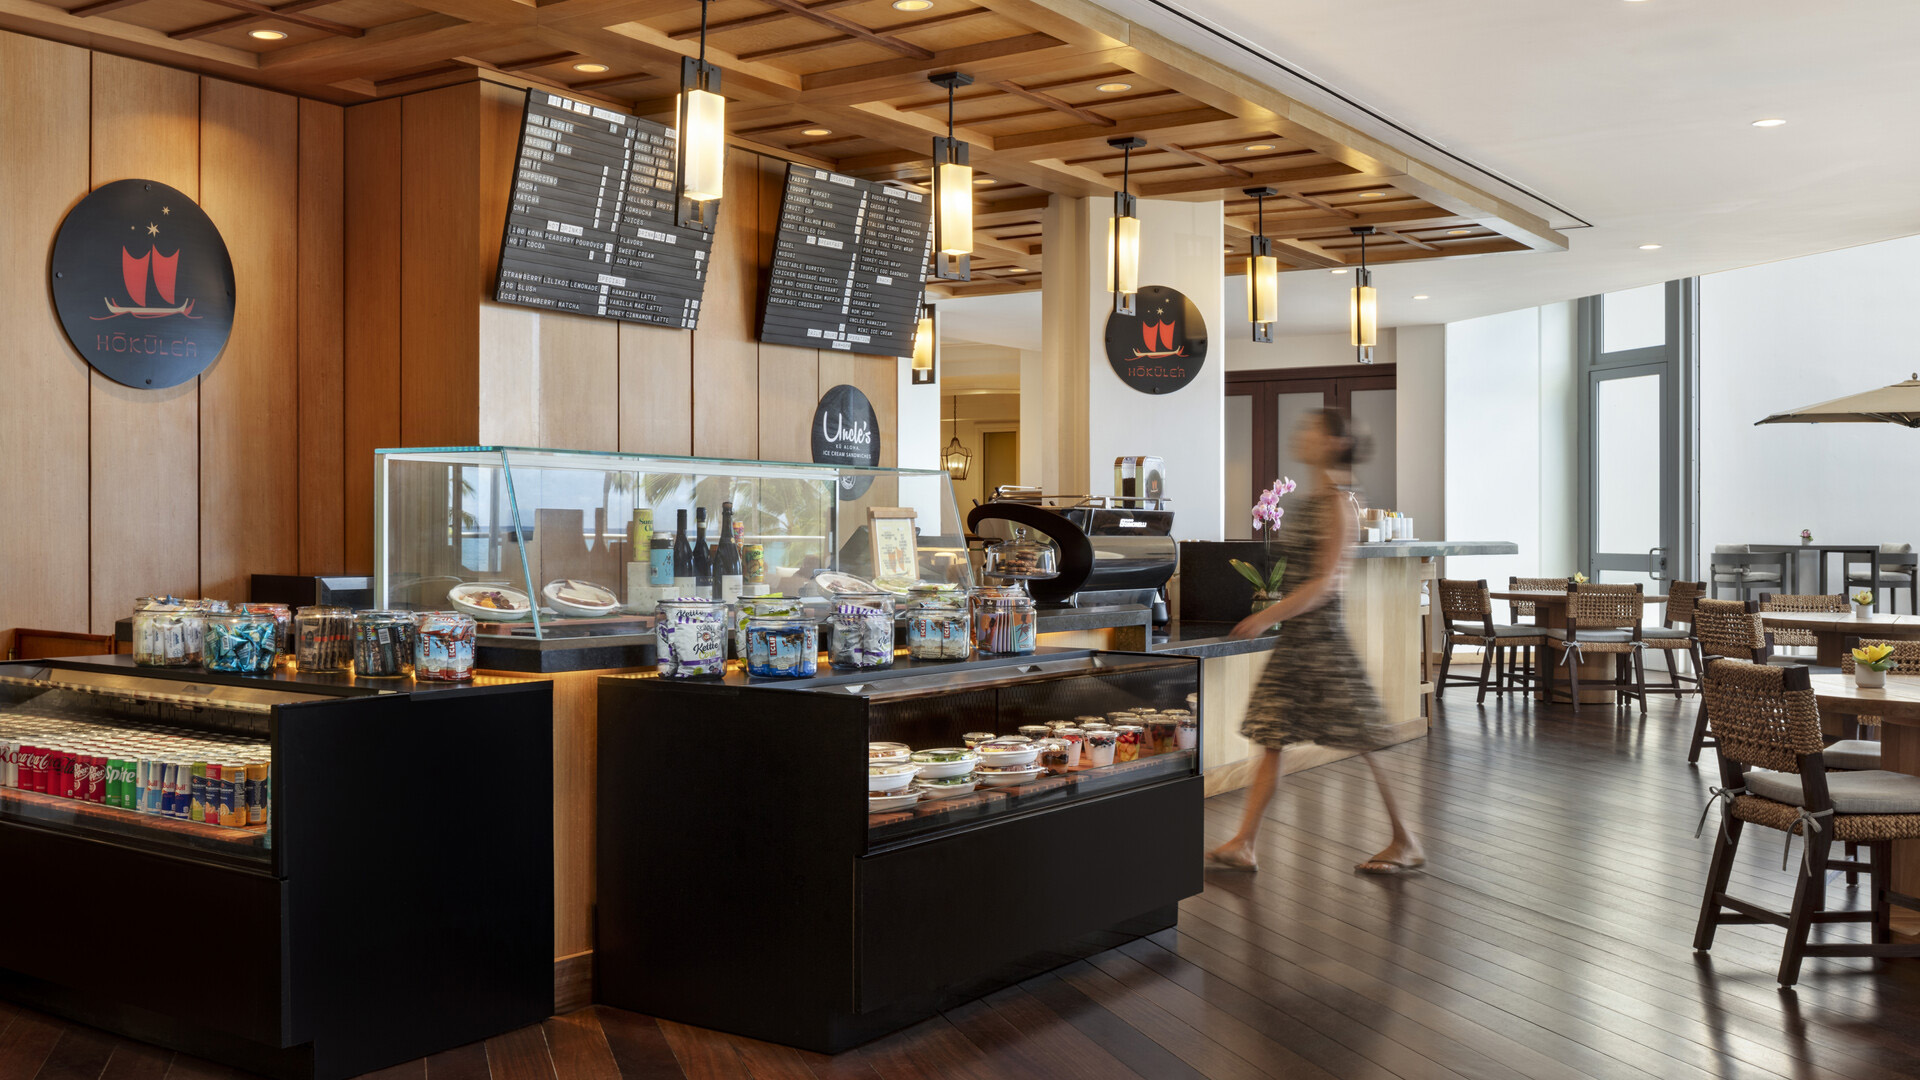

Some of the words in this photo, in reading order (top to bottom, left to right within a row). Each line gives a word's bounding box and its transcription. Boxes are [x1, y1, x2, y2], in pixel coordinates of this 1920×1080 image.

[550, 120, 574, 133] COFFEE
[526, 126, 562, 141] AMERICANO
[525, 137, 552, 150] INFUSED
[556, 144, 572, 154] TEAS
[634, 142, 652, 154] SWEET
[523, 148, 555, 161] ESPRESSO
[520, 159, 541, 170] LATTE
[519, 171, 558, 185] CAPPUCCINO
[791, 176, 809, 185] PASTRY
[517, 182, 538, 192] MOCHA
[628, 184, 650, 195] FREEZY
[790, 185, 807, 194] YOGURT
[810, 190, 831, 199] PARFAIT
[516, 193, 540, 204] MATCHA
[627, 195, 654, 207] WELLNESS
[655, 201, 673, 211] SHOTS
[787, 194, 811, 205] CHIASEED
[813, 200, 833, 209] PUDDING
[513, 204, 530, 213] CHAI
[625, 206, 652, 217] KOMBUCHA
[785, 204, 801, 212] FRUIT
[869, 203, 886, 211] CAESAR
[623, 216, 644, 226] JUICES
[784, 213, 802, 222] SMOKED
[804, 217, 822, 226] SALMON
[822, 221, 837, 229] BAGEL
[868, 212, 884, 220] CHEESE
[547, 222, 559, 231] HOT
[560, 225, 583, 235] DRINKS
[798, 226, 816, 234] BOILED
[901, 227, 920, 236] SANDWICH
[509, 238, 523, 246] HOT
[526, 241, 546, 250] COCOA
[512, 227, 525, 235] 100
[527, 230, 543, 238] KONA
[544, 233, 575, 244] PEABERRY
[575, 239, 604, 250] POUROVER
[619, 237, 644, 247] FLAVORS
[877, 232, 893, 240] CONFIT
[894, 235, 914, 244] SANDWICH
[779, 241, 795, 249] BAGEL
[618, 247, 635, 256] SWEET
[637, 251, 655, 260] CREAM
[778, 250, 796, 259] MUSUBI
[616, 257, 627, 265] ADD
[628, 260, 643, 268] SHOT
[861, 256, 877, 264] TURKEY
[776, 260, 802, 269] VEGETABLE
[805, 264, 826, 273] BURRITO
[860, 265, 878, 273] TRUFFLE
[889, 270, 909, 278] SANDWICH
[503, 270, 542, 283] STRAWBERRY
[543, 277, 569, 287] LILIKOI
[570, 281, 598, 292] LEMONADE
[598, 275, 625, 286] SPECIALS
[774, 269, 796, 278] CHICKEN
[797, 273, 817, 281] SAUSAGE
[818, 276, 839, 284] BURRITO
[500, 281, 514, 289] POG
[517, 284, 537, 293] SLUSH
[795, 282, 813, 290] CHEESE
[500, 292, 516, 301] ICED
[517, 295, 555, 307] STRAWBERRY
[557, 301, 580, 310] MATCHA
[611, 289, 639, 298] HAWAIIAN
[640, 293, 657, 301] LATTE
[802, 292, 822, 300] ENGLISH
[823, 295, 841, 303] MUFFIN
[853, 291, 873, 299] DESSERT
[609, 299, 632, 308] VANILLA
[646, 304, 663, 312] LATTE
[770, 297, 796, 306] BREAKFAST
[607, 309, 624, 317] HONEY
[625, 312, 653, 321] CINNAMON
[653, 316, 669, 324] LATTE
[867, 320, 887, 328] HAWAIIAN
[823, 411, 871, 444] Uncle's
[693, 642, 719, 655] Kettle
